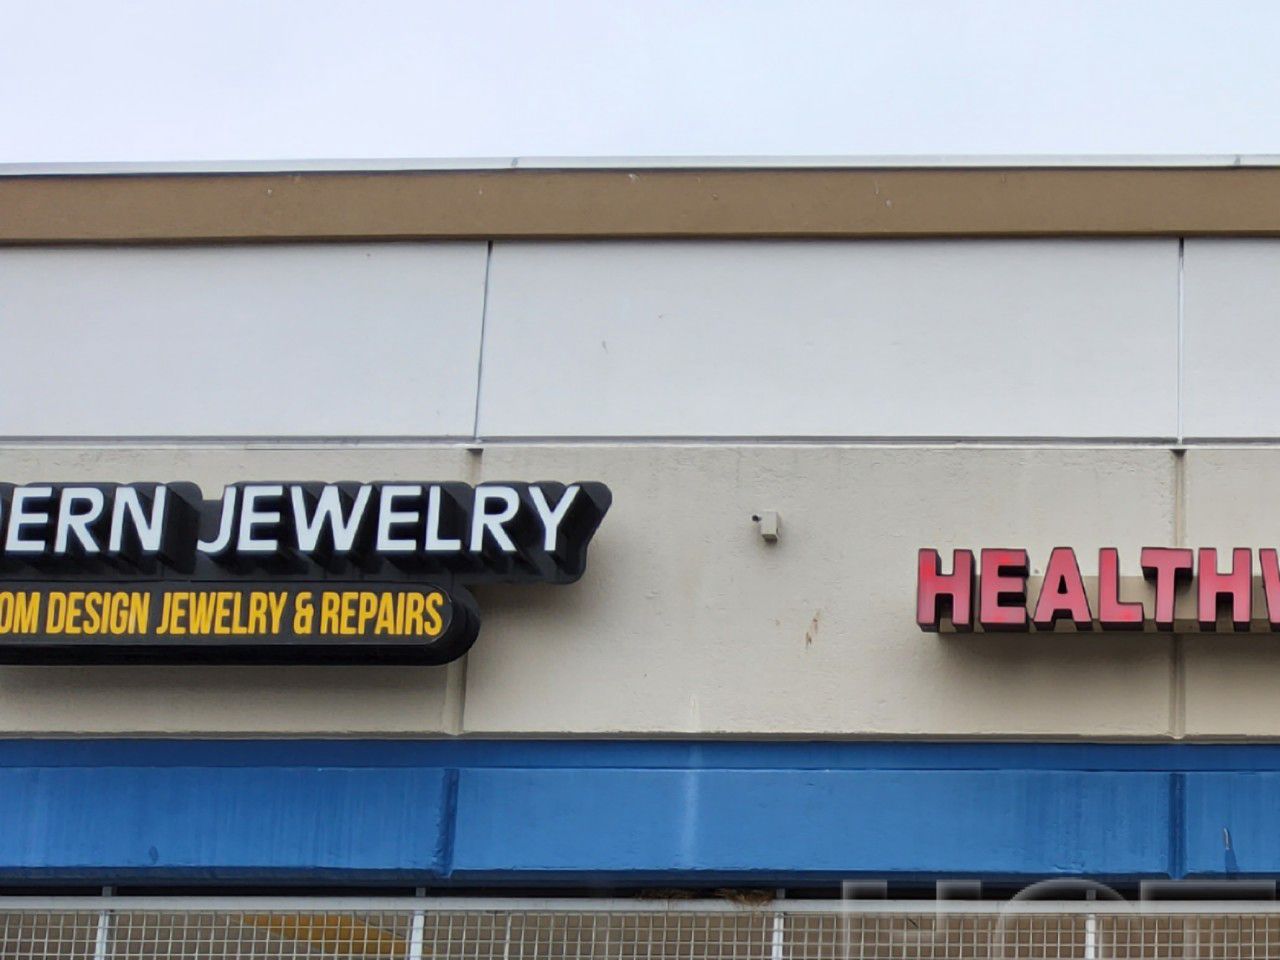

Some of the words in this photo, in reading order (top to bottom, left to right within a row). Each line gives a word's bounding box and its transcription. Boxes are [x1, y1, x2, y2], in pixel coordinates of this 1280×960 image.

[0, 486, 166, 553] ERN
[196, 486, 581, 553] JEWELRY
[46, 591, 151, 635] DESIGN
[156, 591, 288, 635] JEWELRY
[294, 591, 312, 635] &
[320, 591, 444, 635] REPAIRS
